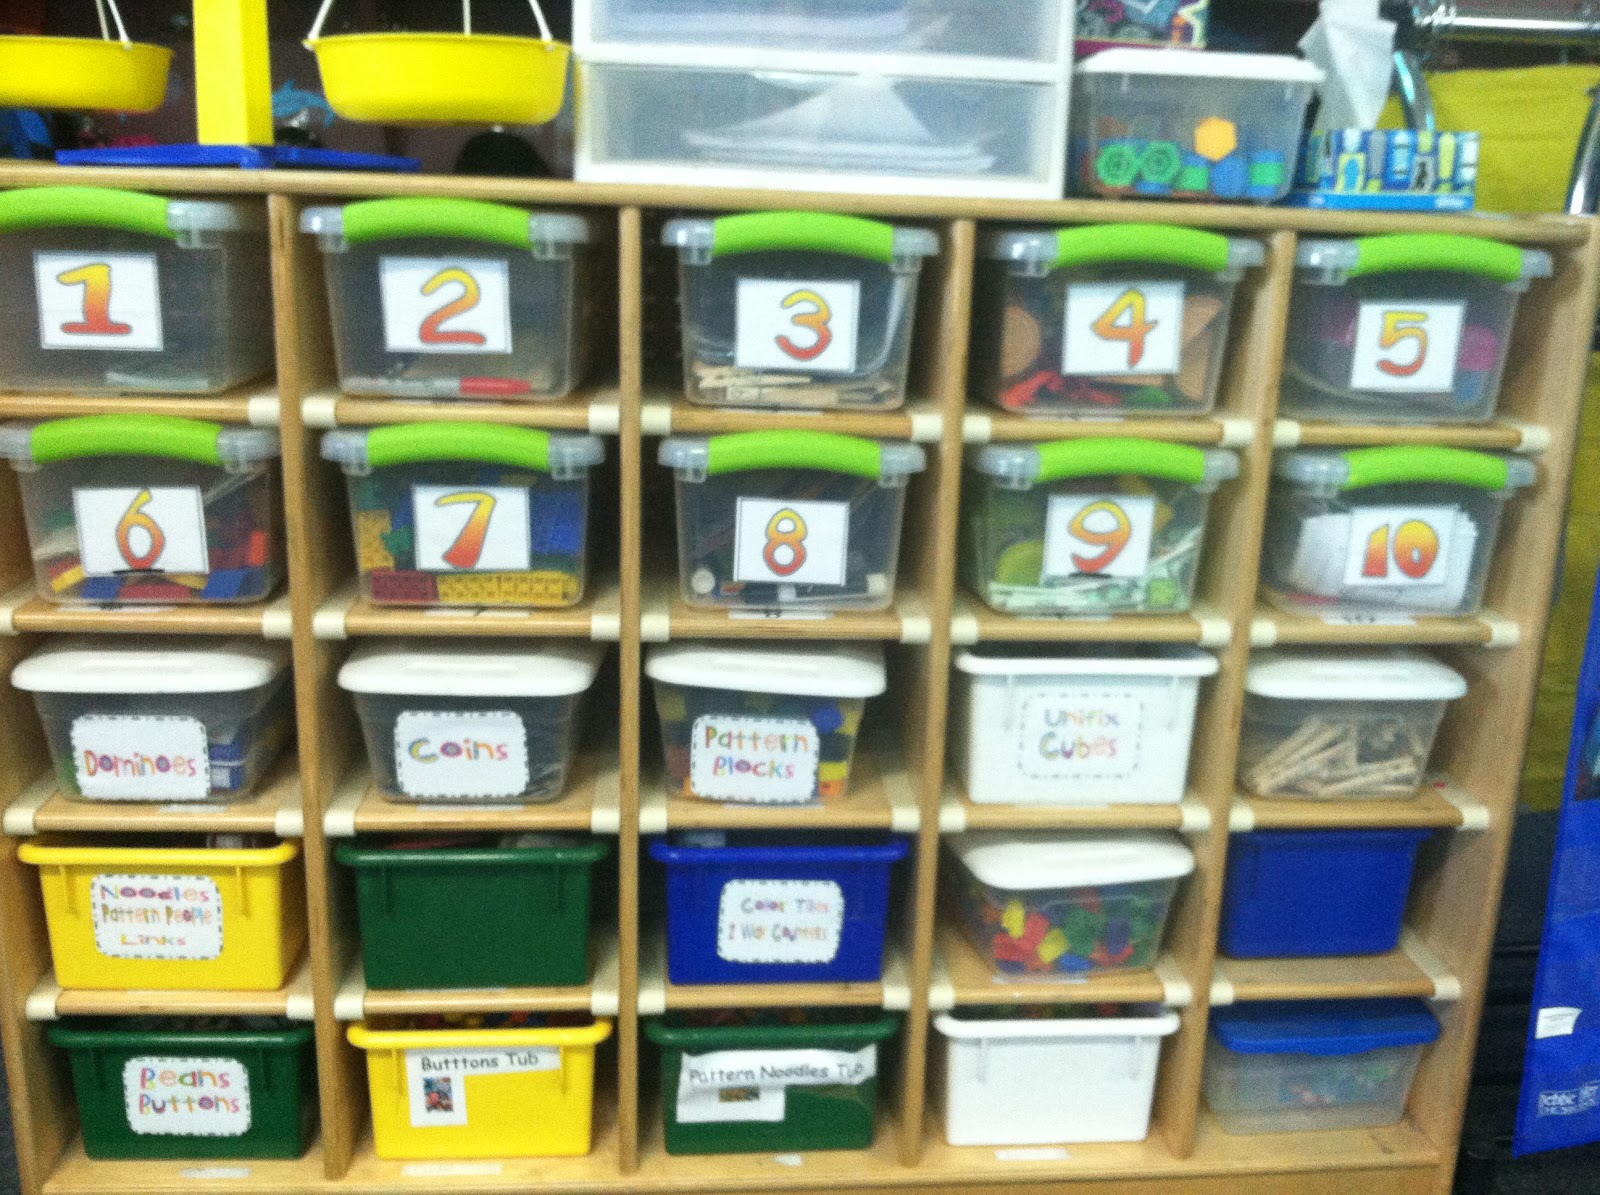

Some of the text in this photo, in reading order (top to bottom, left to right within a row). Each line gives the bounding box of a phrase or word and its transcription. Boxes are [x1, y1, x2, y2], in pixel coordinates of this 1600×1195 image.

[57, 263, 132, 335] 1
[419, 268, 486, 345] 2
[775, 289, 833, 360] 3
[1091, 289, 1158, 367] 4
[1377, 311, 1429, 377] 5
[116, 489, 166, 569] 6
[435, 492, 496, 569] 7
[763, 507, 808, 576] 8
[1068, 502, 1132, 574] 9
[1363, 520, 1440, 579] 10
[407, 737, 509, 764] Coins
[703, 725, 810, 752] Pattern
[1039, 731, 1117, 760] Cubes
[84, 750, 197, 777] Dominoes
[711, 755, 796, 781] Blocks
[100, 884, 209, 902] Noodles
[140, 1067, 231, 1090] Beans
[505, 1050, 539, 1066] Tub
[760, 1063, 829, 1081] Noodles
[139, 1094, 240, 1115] Buttons
